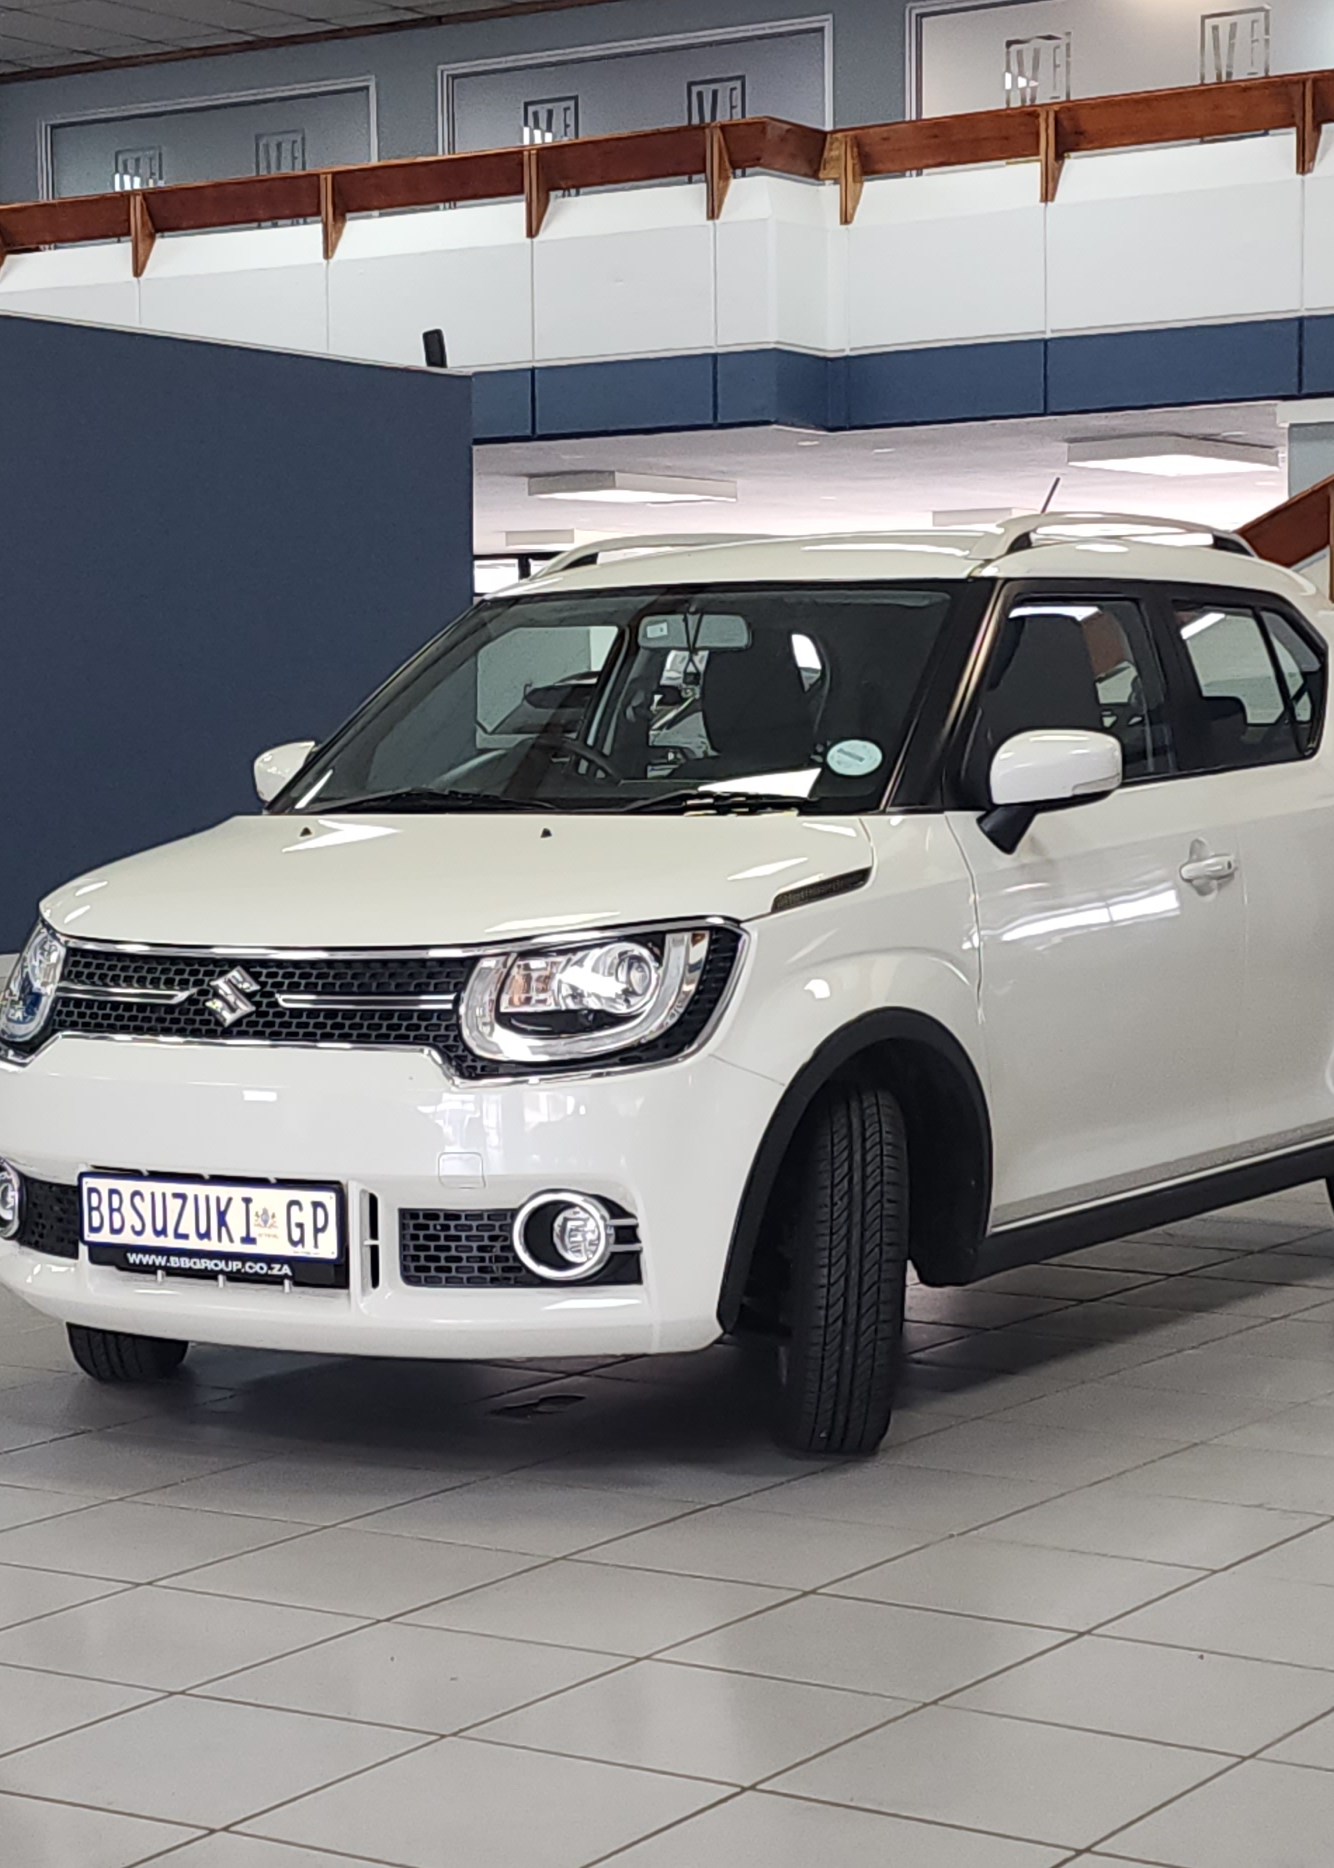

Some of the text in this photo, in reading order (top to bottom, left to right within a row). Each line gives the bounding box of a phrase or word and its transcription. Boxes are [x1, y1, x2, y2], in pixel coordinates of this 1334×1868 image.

[86, 1186, 329, 1249] BBSUZUKI GP
[126, 1252, 293, 1276] WWW.BBGROUP.CO.ZA
